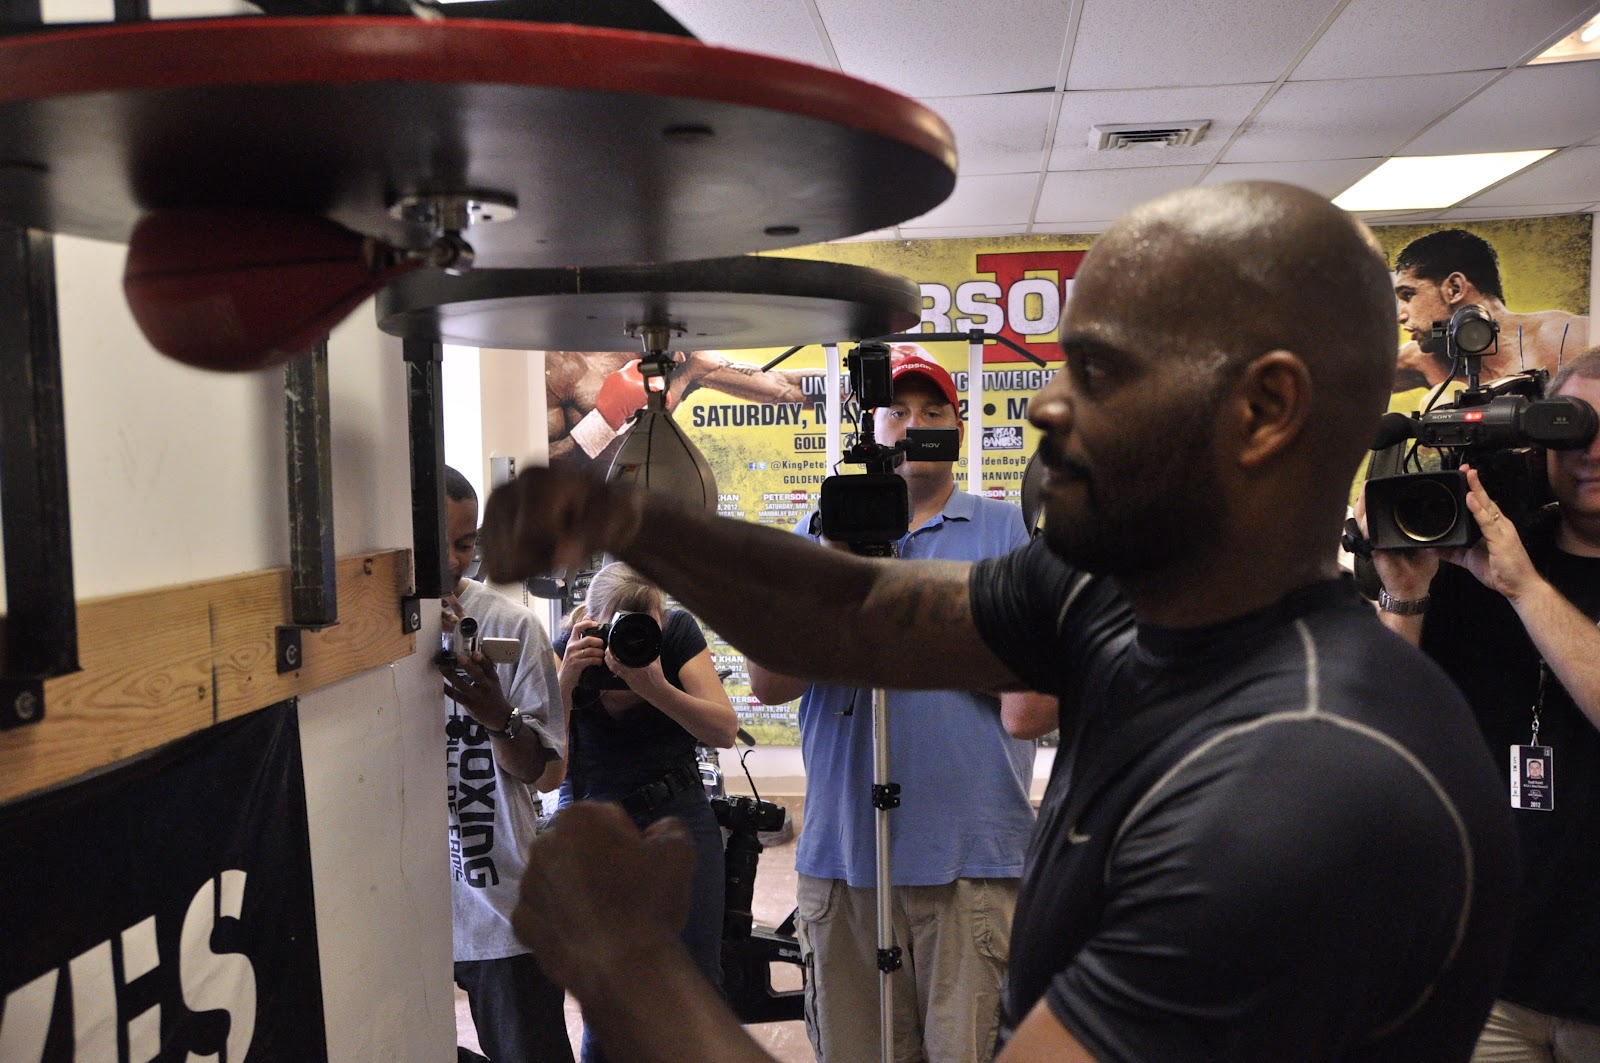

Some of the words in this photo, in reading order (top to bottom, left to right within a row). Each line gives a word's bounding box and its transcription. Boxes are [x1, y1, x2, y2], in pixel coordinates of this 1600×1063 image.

[905, 278, 1077, 337] RSO
[693, 404, 807, 429] SATURDAY,
[794, 436, 827, 450] GOLD
[783, 475, 826, 484] GOLDENB
[763, 493, 808, 501] PETERSON
[719, 655, 744, 663] KHAN
[458, 715, 500, 889] BOXING
